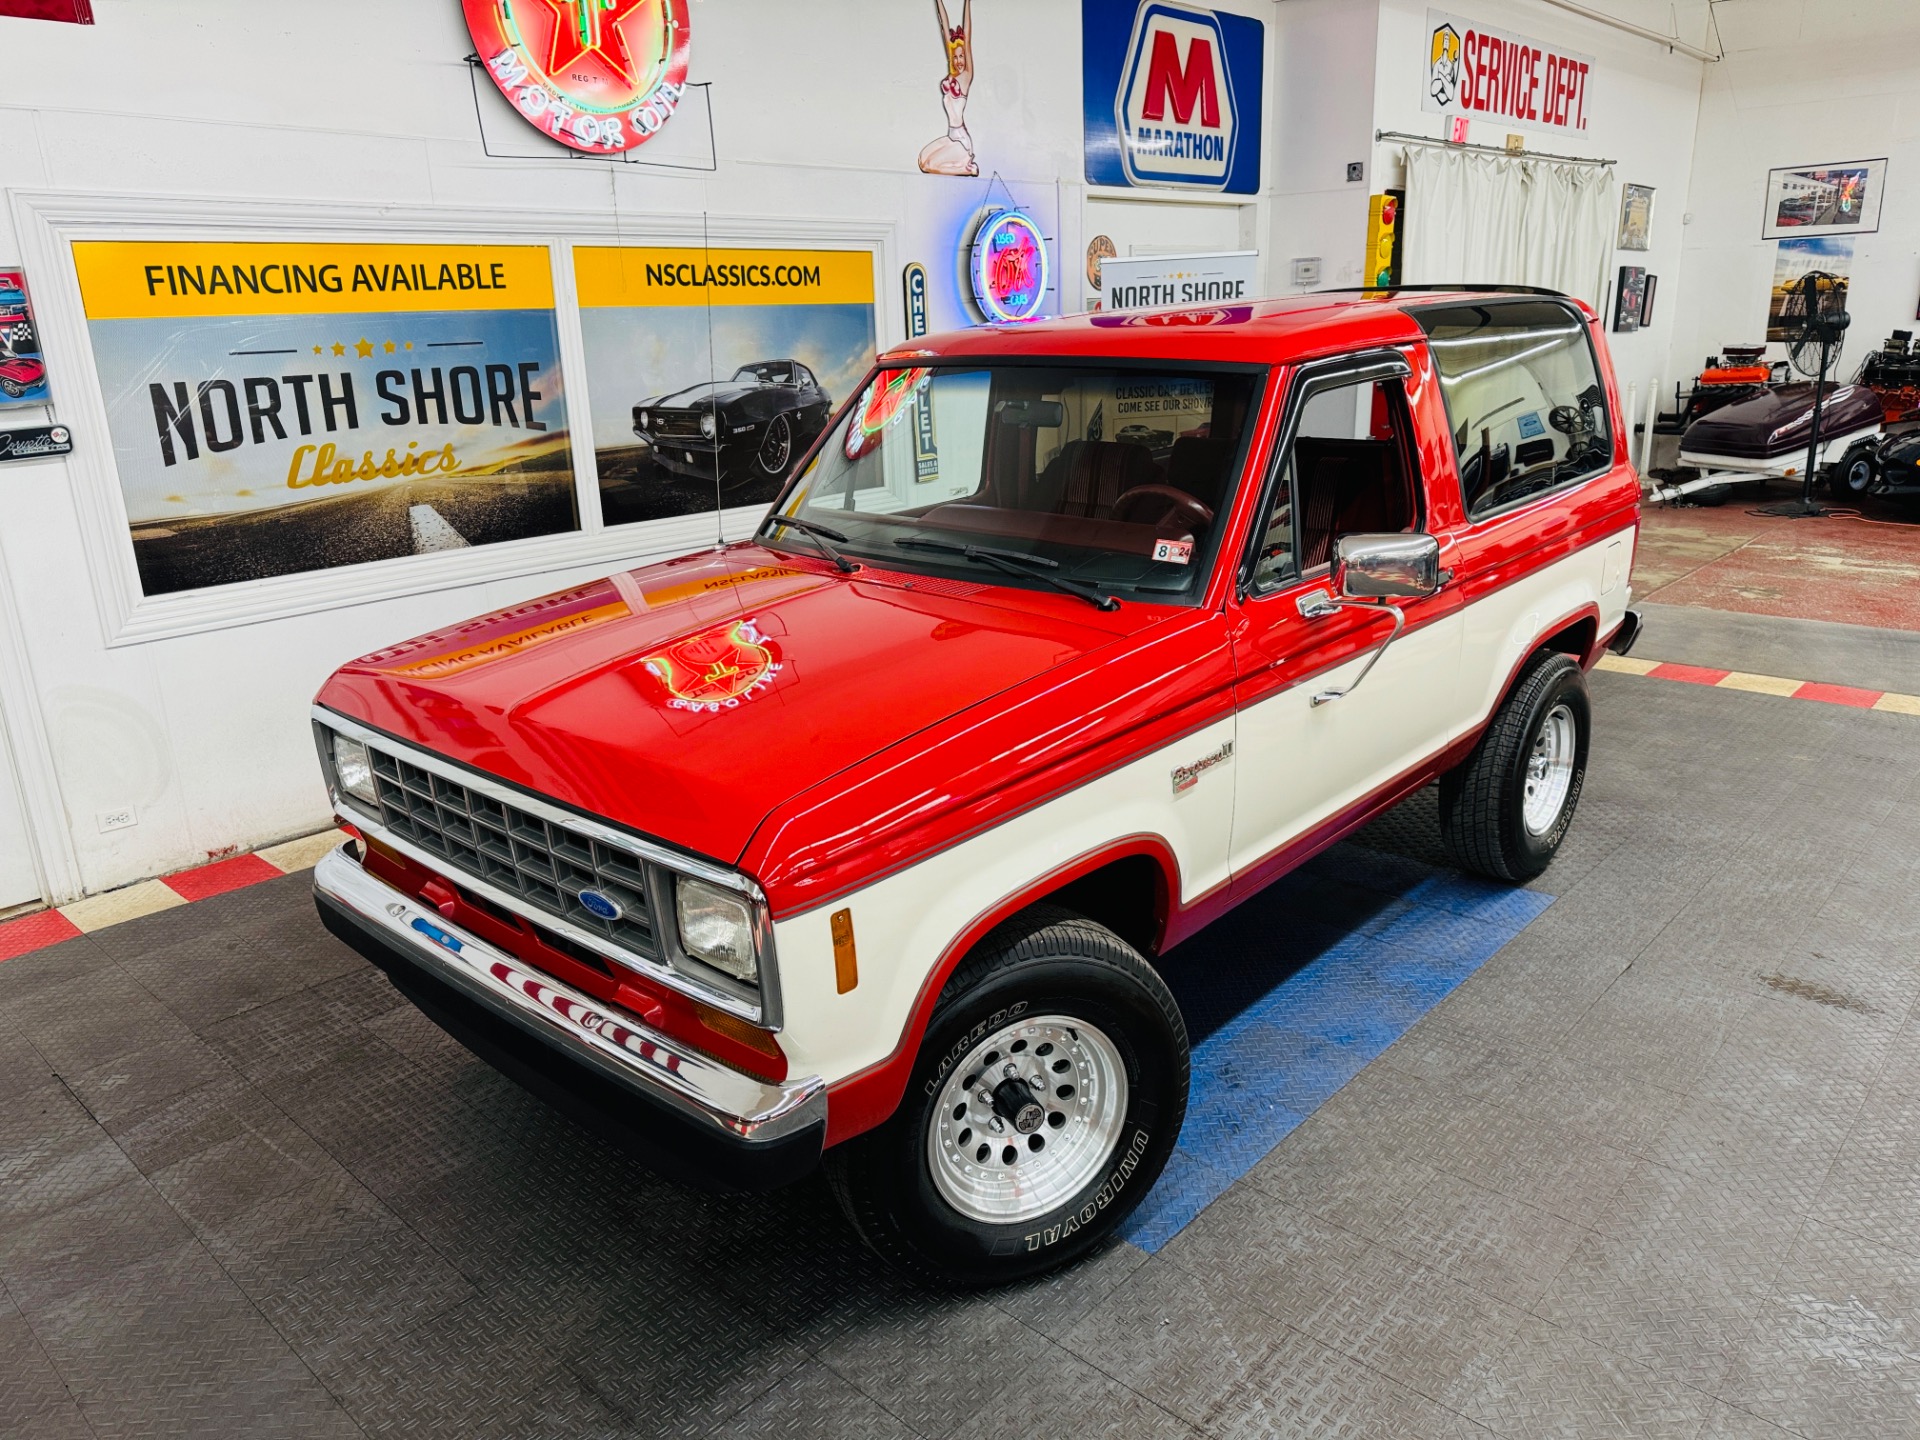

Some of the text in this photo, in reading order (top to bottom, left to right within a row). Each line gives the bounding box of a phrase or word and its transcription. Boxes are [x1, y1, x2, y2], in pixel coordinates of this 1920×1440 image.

[571, 73, 589, 83] REG
[1142, 30, 1220, 128] M
[1461, 29, 1588, 130] SERVICE DEPT.
[488, 48, 686, 149] MOTOR OIL
[1137, 127, 1224, 161] MARATHON
[144, 262, 507, 296] FINANCING AVAILABLE
[645, 264, 820, 287] NSCLASSICS.COM
[1112, 284, 1174, 309] NORTH
[1182, 280, 1244, 303] SHORE
[1116, 385, 1154, 400] CLASSIC
[1118, 401, 1142, 414] COME
[1144, 400, 1160, 412] SEE
[1163, 399, 1180, 411] OUR
[149, 361, 547, 467] NORTH SHORE
[286, 440, 462, 490] Classics
[1158, 545, 1190, 557] 8 24
[924, 1001, 1028, 1097] LAREDO
[1025, 1130, 1149, 1252] UNIROYAL
